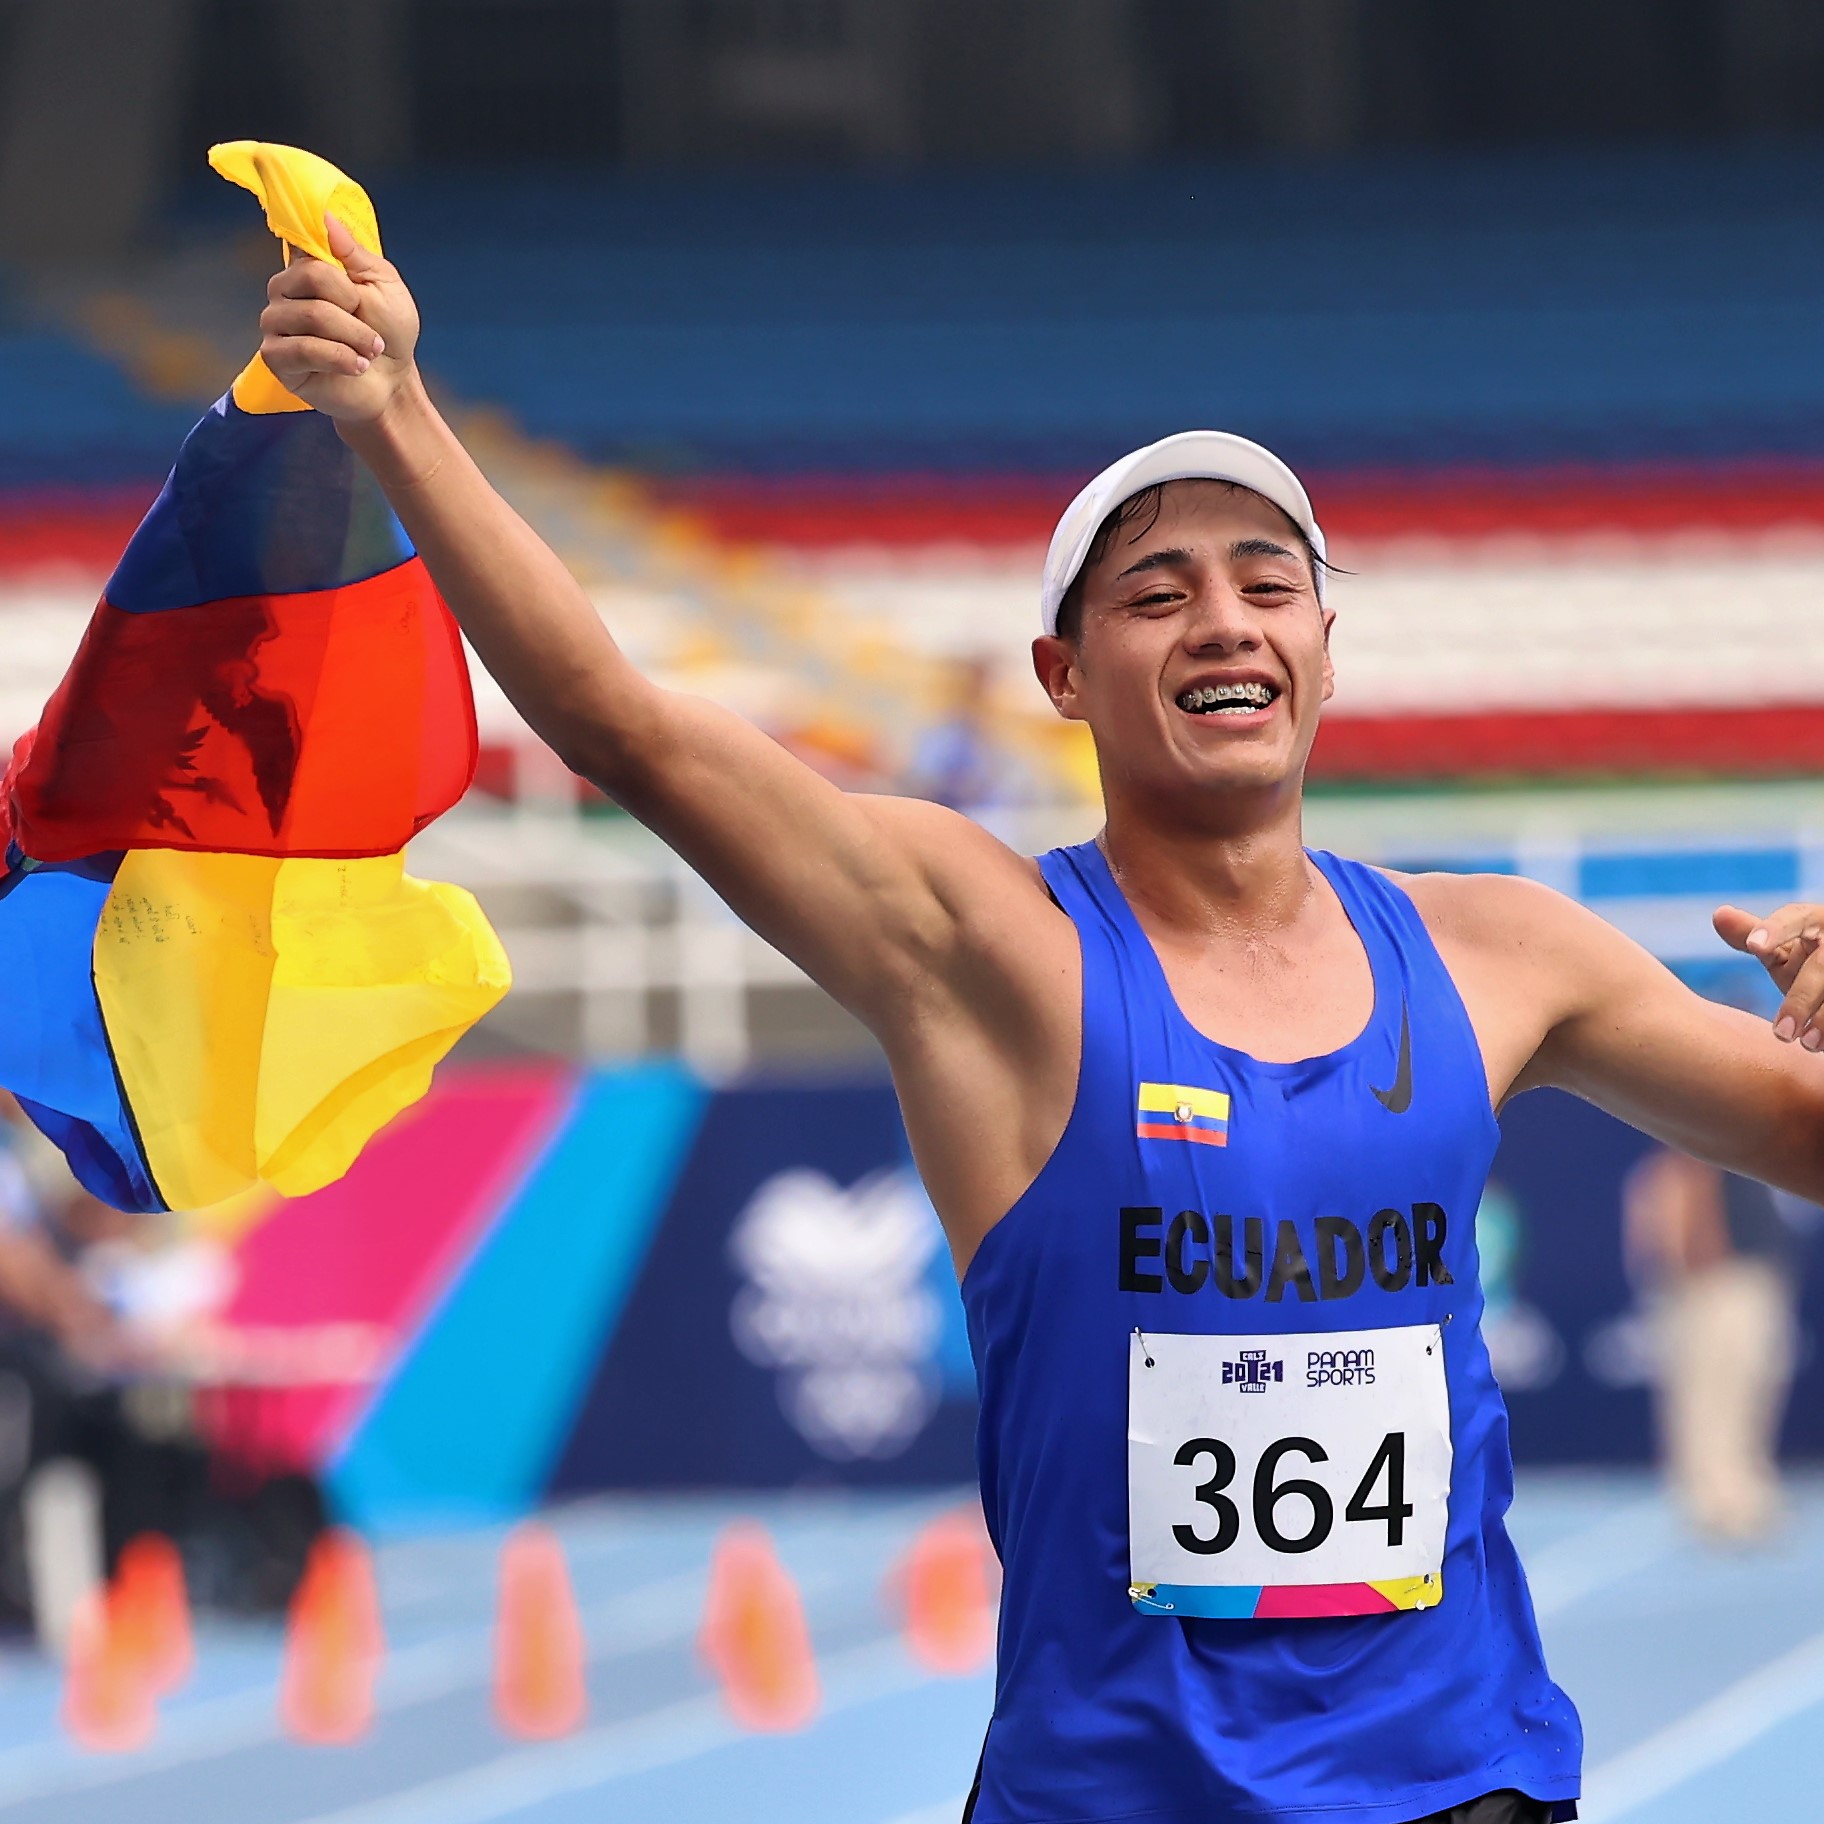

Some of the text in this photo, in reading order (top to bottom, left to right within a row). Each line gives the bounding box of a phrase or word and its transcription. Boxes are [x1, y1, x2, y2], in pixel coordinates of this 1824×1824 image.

[1119, 1202, 1455, 1303] ECUADOR
[1307, 1349, 1375, 1369] PANAM
[1240, 1383, 1266, 1392] VALLE
[1306, 1367, 1376, 1388] SPORTS
[1171, 1431, 1413, 1555] 364
